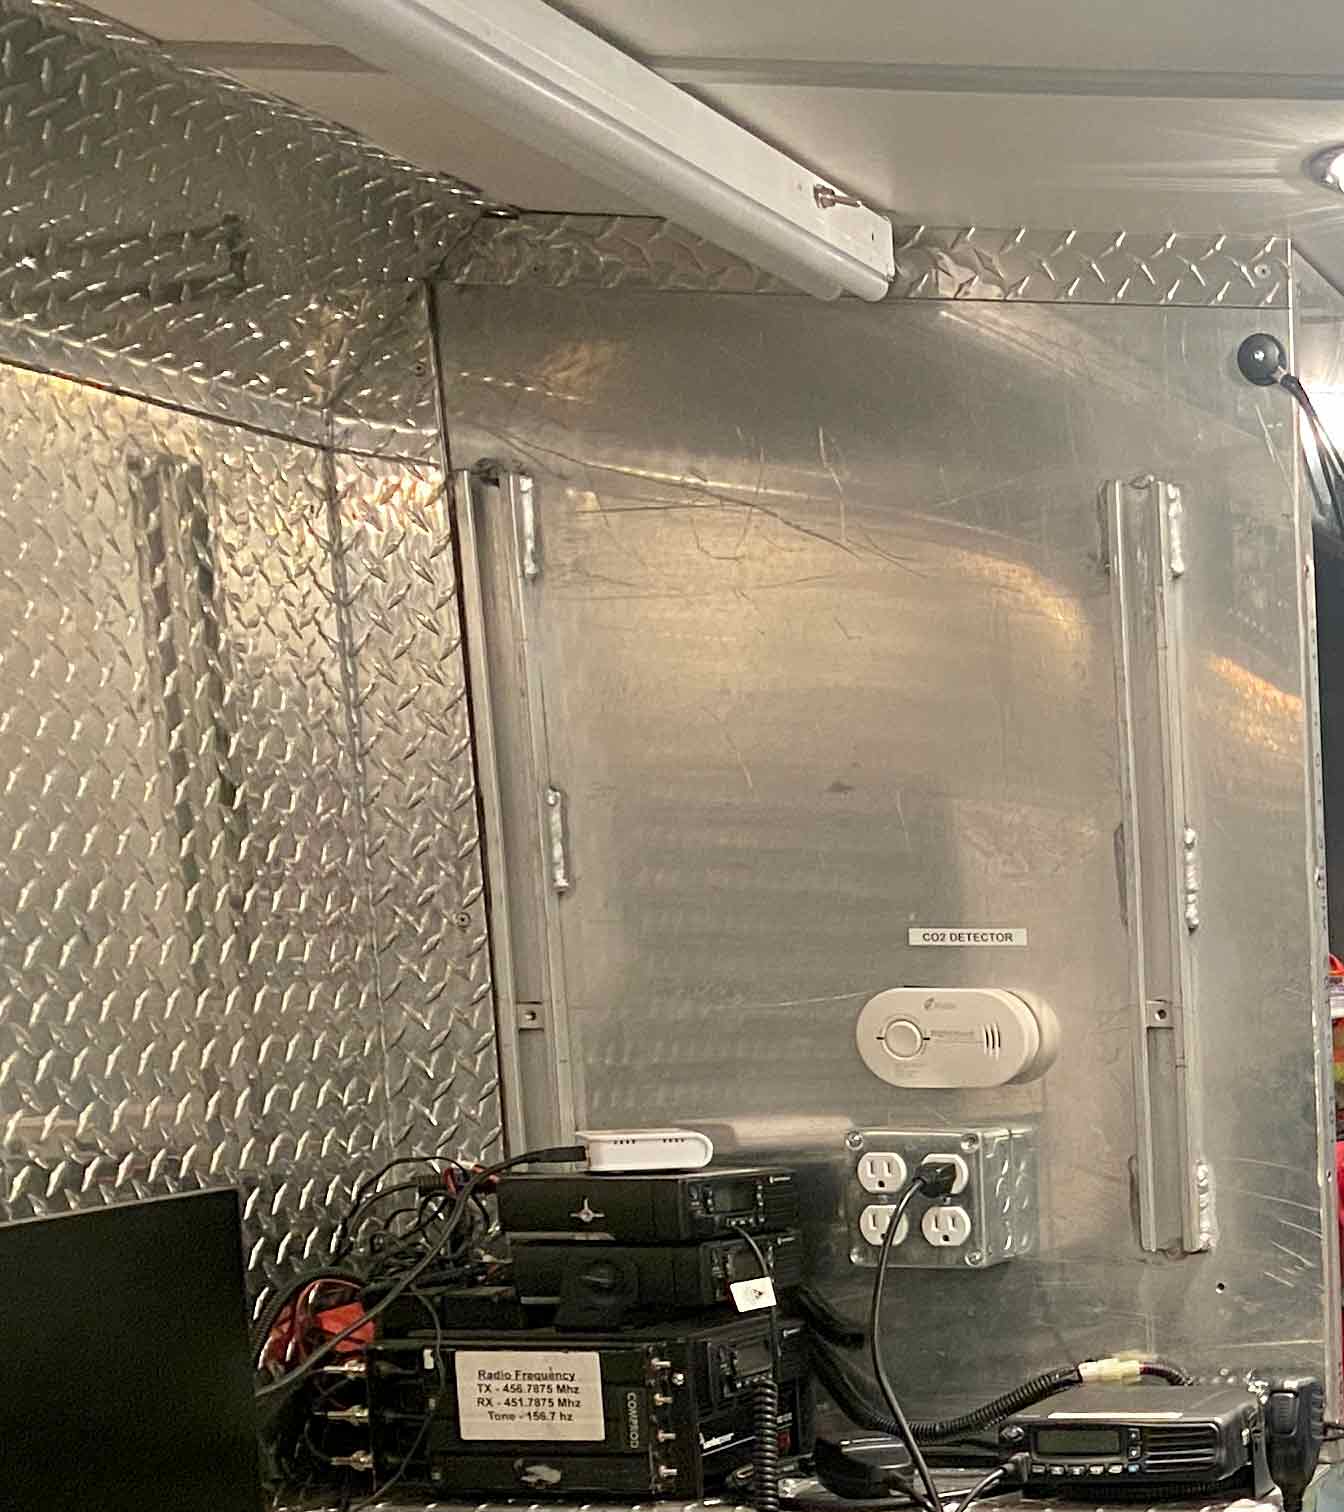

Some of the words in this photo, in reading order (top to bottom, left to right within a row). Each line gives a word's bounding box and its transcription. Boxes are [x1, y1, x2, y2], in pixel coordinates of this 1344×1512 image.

[922, 932, 946, 943] CO2
[949, 932, 1013, 943] DETECTOR
[478, 1370, 512, 1381] Radio
[515, 1370, 576, 1382] Frequency
[477, 1384, 492, 1394] TX
[556, 1384, 580, 1394] Mhz
[476, 1397, 494, 1408] RX
[557, 1397, 581, 1408] Mhz
[488, 1411, 516, 1421] Tone
[559, 1411, 574, 1421] hz
